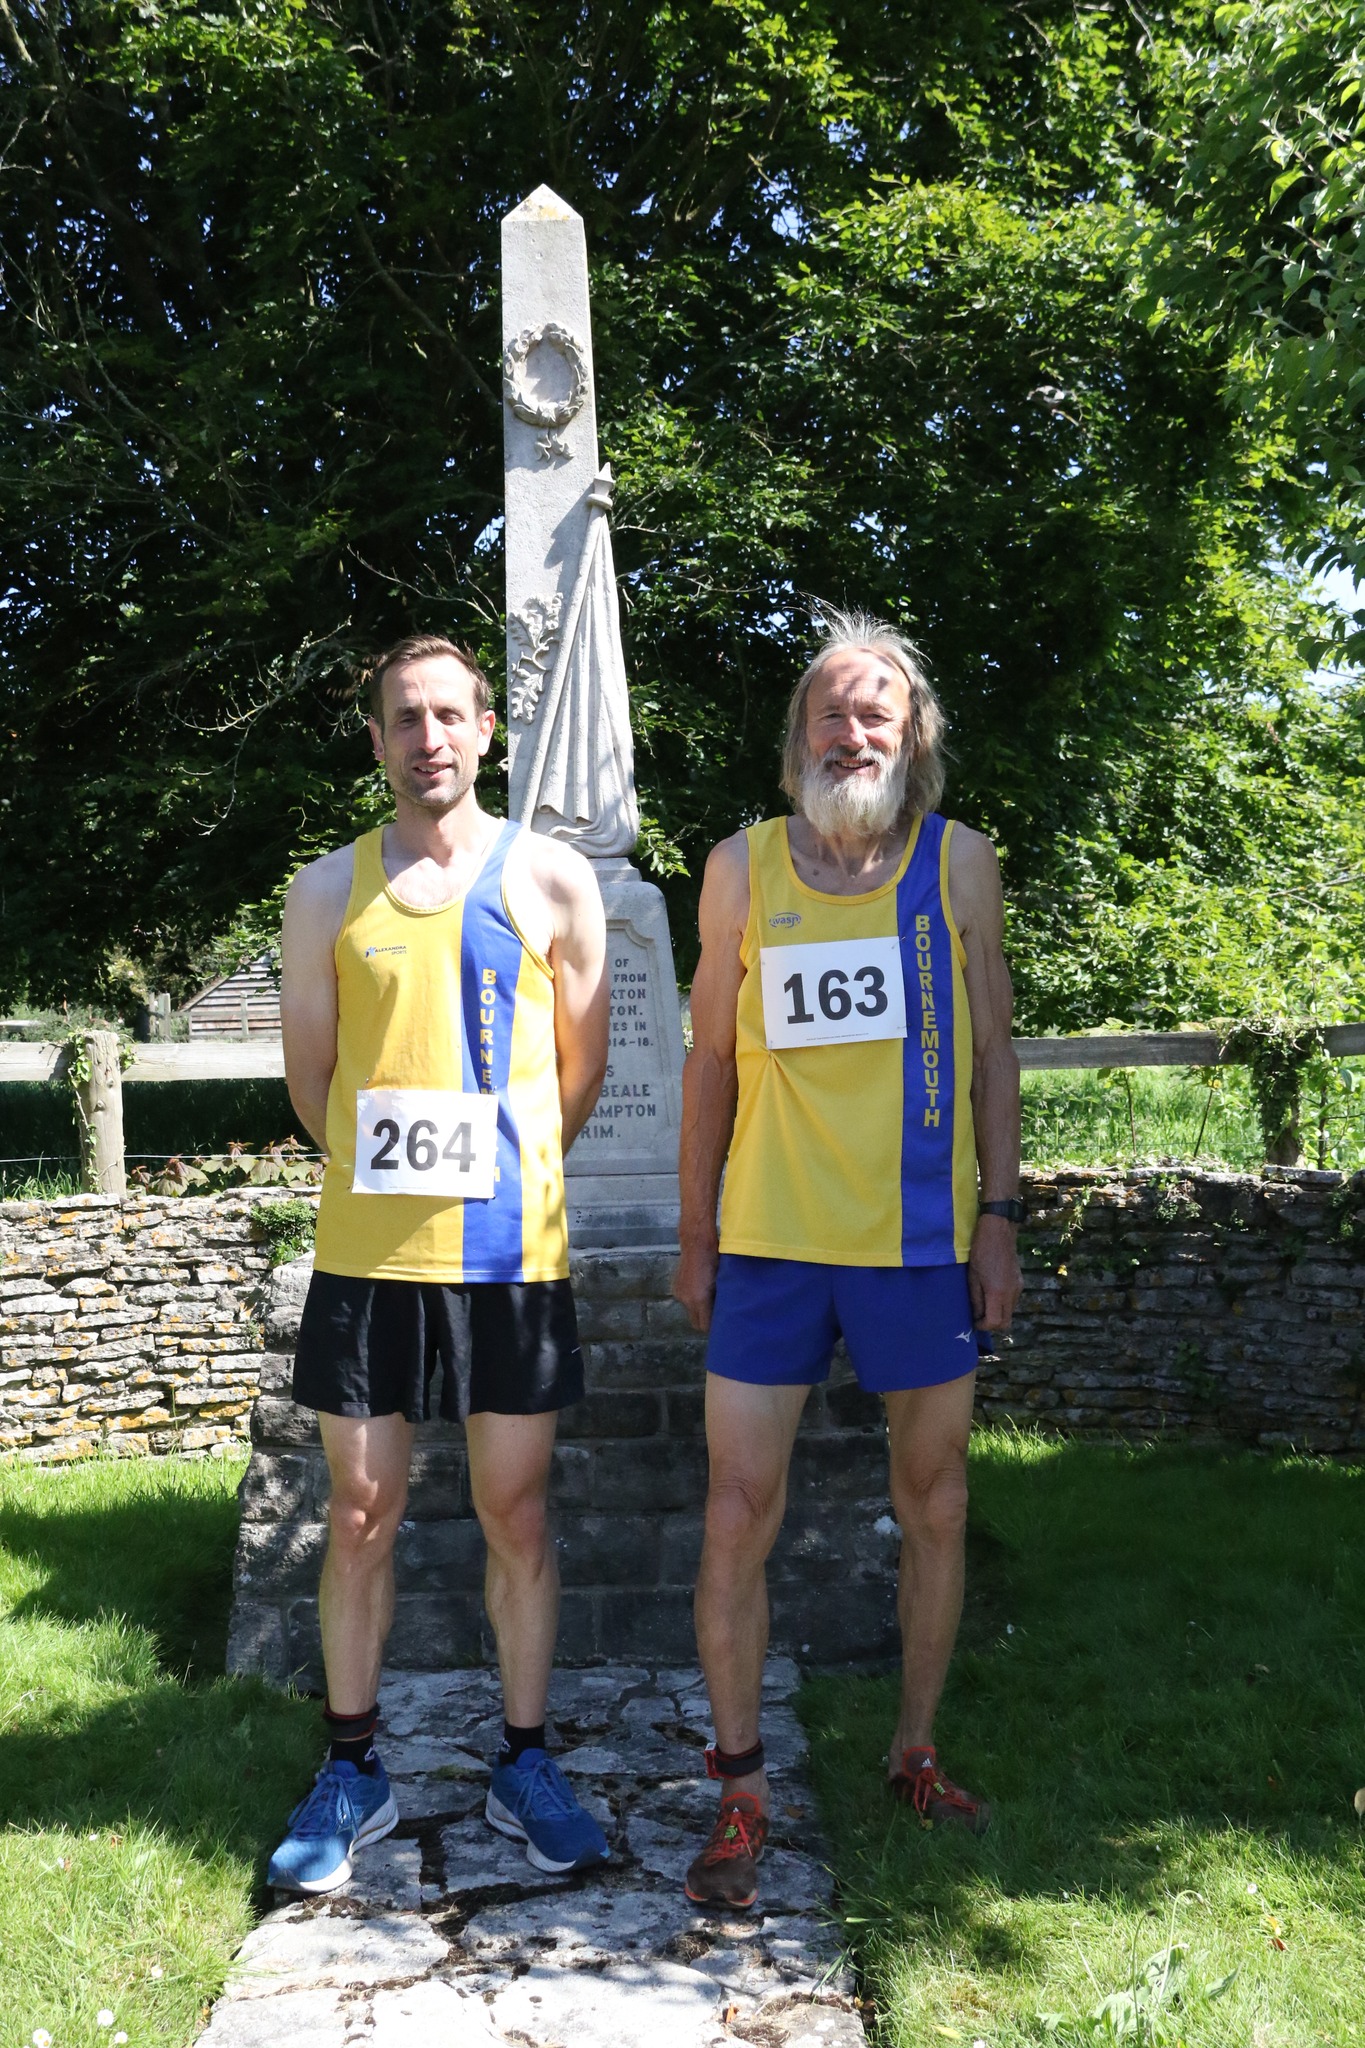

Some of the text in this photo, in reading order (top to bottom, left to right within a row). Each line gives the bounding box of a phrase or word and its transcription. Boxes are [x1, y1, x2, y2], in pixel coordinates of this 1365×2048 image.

[615, 958, 629, 968] OF
[614, 973, 647, 983] FROM
[783, 966, 888, 1025] 163
[634, 1021, 647, 1031] IN
[915, 914, 940, 1127] BOURNEMOUTH
[600, 1084, 651, 1098] BEALE
[370, 1118, 476, 1172] 264
